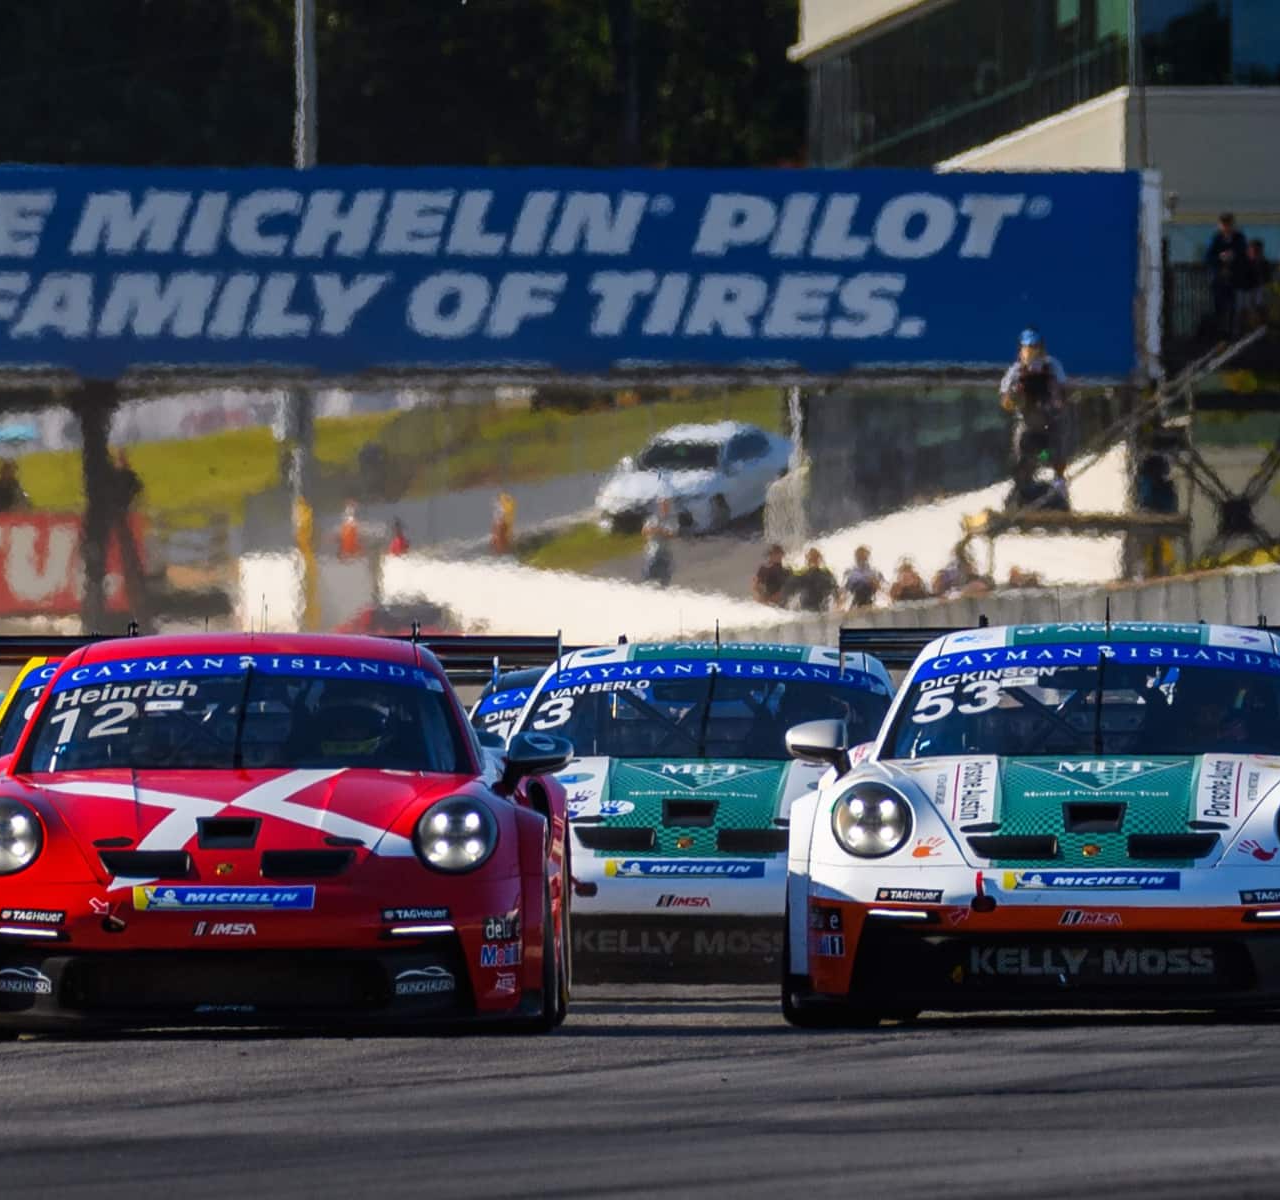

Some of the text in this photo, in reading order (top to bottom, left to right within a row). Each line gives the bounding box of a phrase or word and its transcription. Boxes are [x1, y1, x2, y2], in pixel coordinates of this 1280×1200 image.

[405, 269, 568, 338] OF
[587, 269, 927, 339] TIRES.
[72, 657, 224, 681] CAYMAN
[932, 648, 1082, 670] CAYMAN
[558, 663, 693, 684] CAYMAN
[920, 666, 1057, 691] DICKINSON
[55, 680, 198, 710] Heinrich
[550, 679, 650, 700] VAN BERLO
[533, 697, 574, 730] 3
[911, 680, 1002, 724] 53
[50, 701, 138, 745] 12
[1204, 780, 1231, 818] Porsche
[650, 865, 751, 873] MICHELIN
[1052, 876, 1166, 886] MICHELIN
[184, 892, 298, 903] MICHELIN
[211, 923, 257, 936] IMSA
[972, 947, 1214, 975] KELLY MOSS
